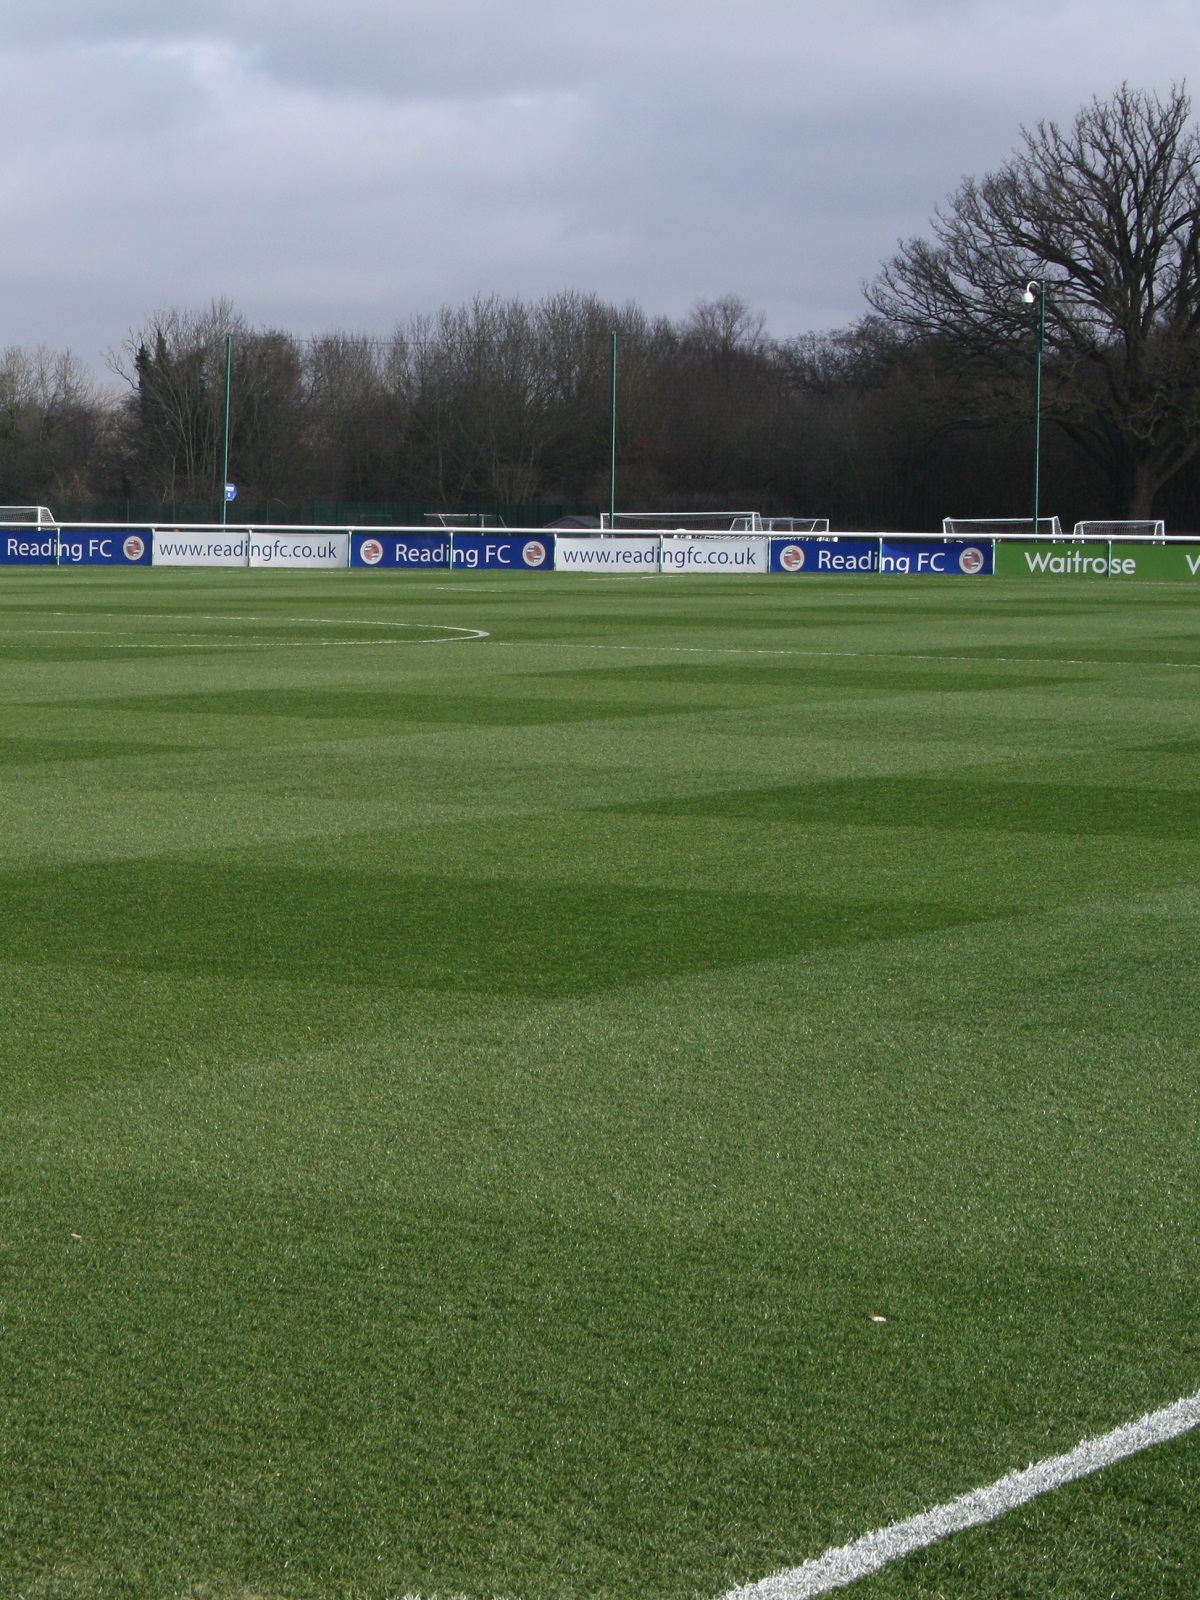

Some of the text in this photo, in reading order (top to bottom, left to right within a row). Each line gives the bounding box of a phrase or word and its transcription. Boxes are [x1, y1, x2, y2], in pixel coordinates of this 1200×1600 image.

[7, 538, 113, 562] Reading FC
[159, 540, 337, 562] www.readingfc.co.uk
[395, 543, 511, 568] Reading FC
[563, 546, 756, 568] www.readingfc.co.uk
[818, 550, 946, 574] Reading FC
[1024, 550, 1136, 575] Waitrose
